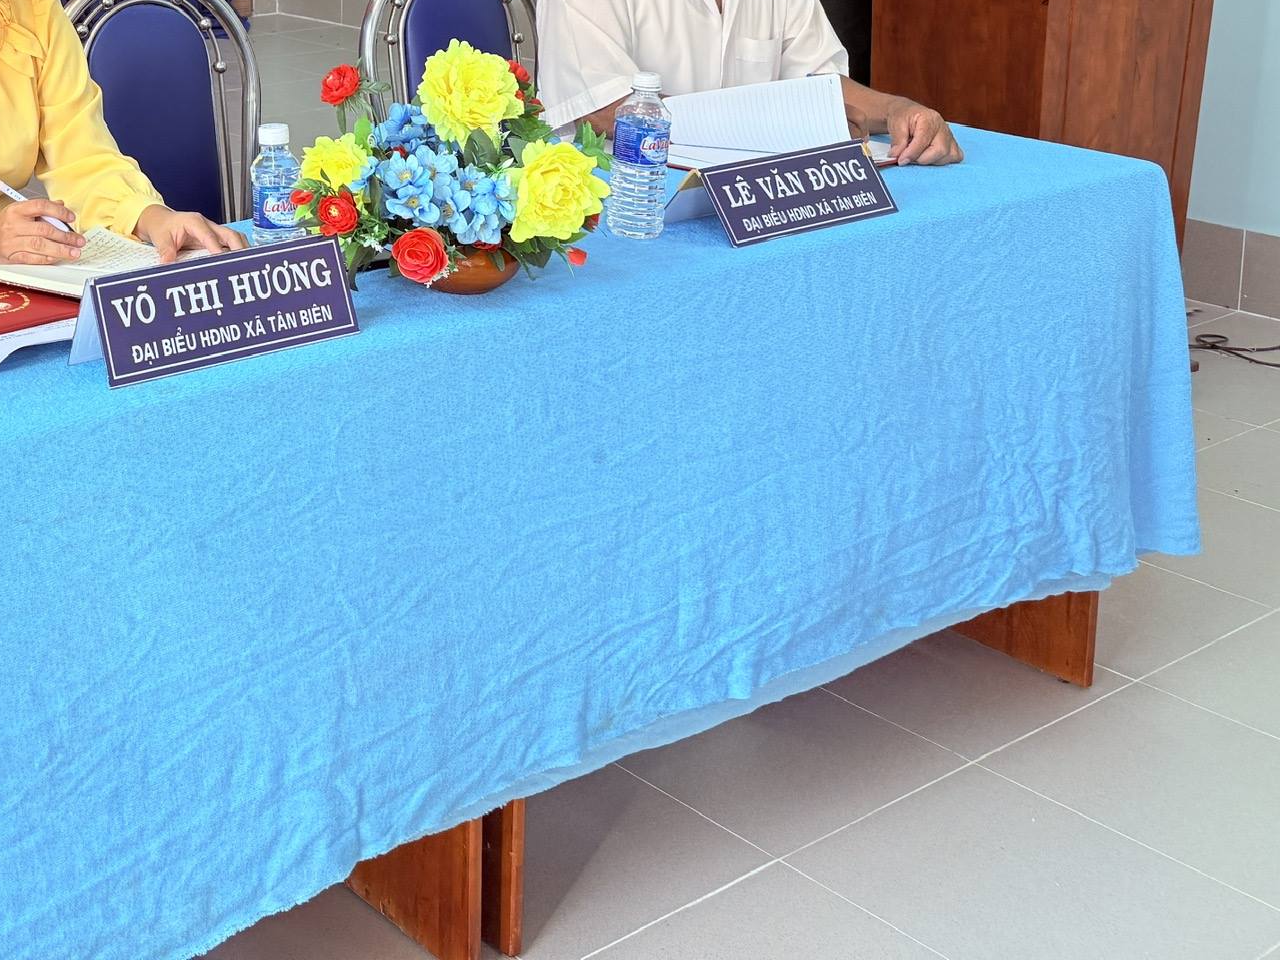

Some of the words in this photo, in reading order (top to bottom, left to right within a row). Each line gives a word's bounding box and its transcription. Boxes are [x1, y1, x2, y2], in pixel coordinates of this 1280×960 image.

[722, 175, 757, 208] LÊ
[755, 167, 806, 200] VĂN
[804, 158, 868, 191] ĐÔNG
[742, 215, 764, 234] ĐẠI
[762, 205, 788, 228] BIỂU
[815, 198, 834, 216] XÃ
[831, 195, 854, 212] TÂN
[854, 190, 878, 209] BIÊN
[111, 285, 156, 328] VÕ
[166, 278, 224, 316] THỊ
[228, 257, 332, 305] HƯƠNG
[131, 342, 160, 366] ĐẠI
[163, 326, 197, 357] BIỂU
[200, 323, 241, 348] HĐND
[245, 315, 266, 339] XÃ
[267, 310, 298, 332] TÂN
[299, 304, 333, 326] BIÊN
